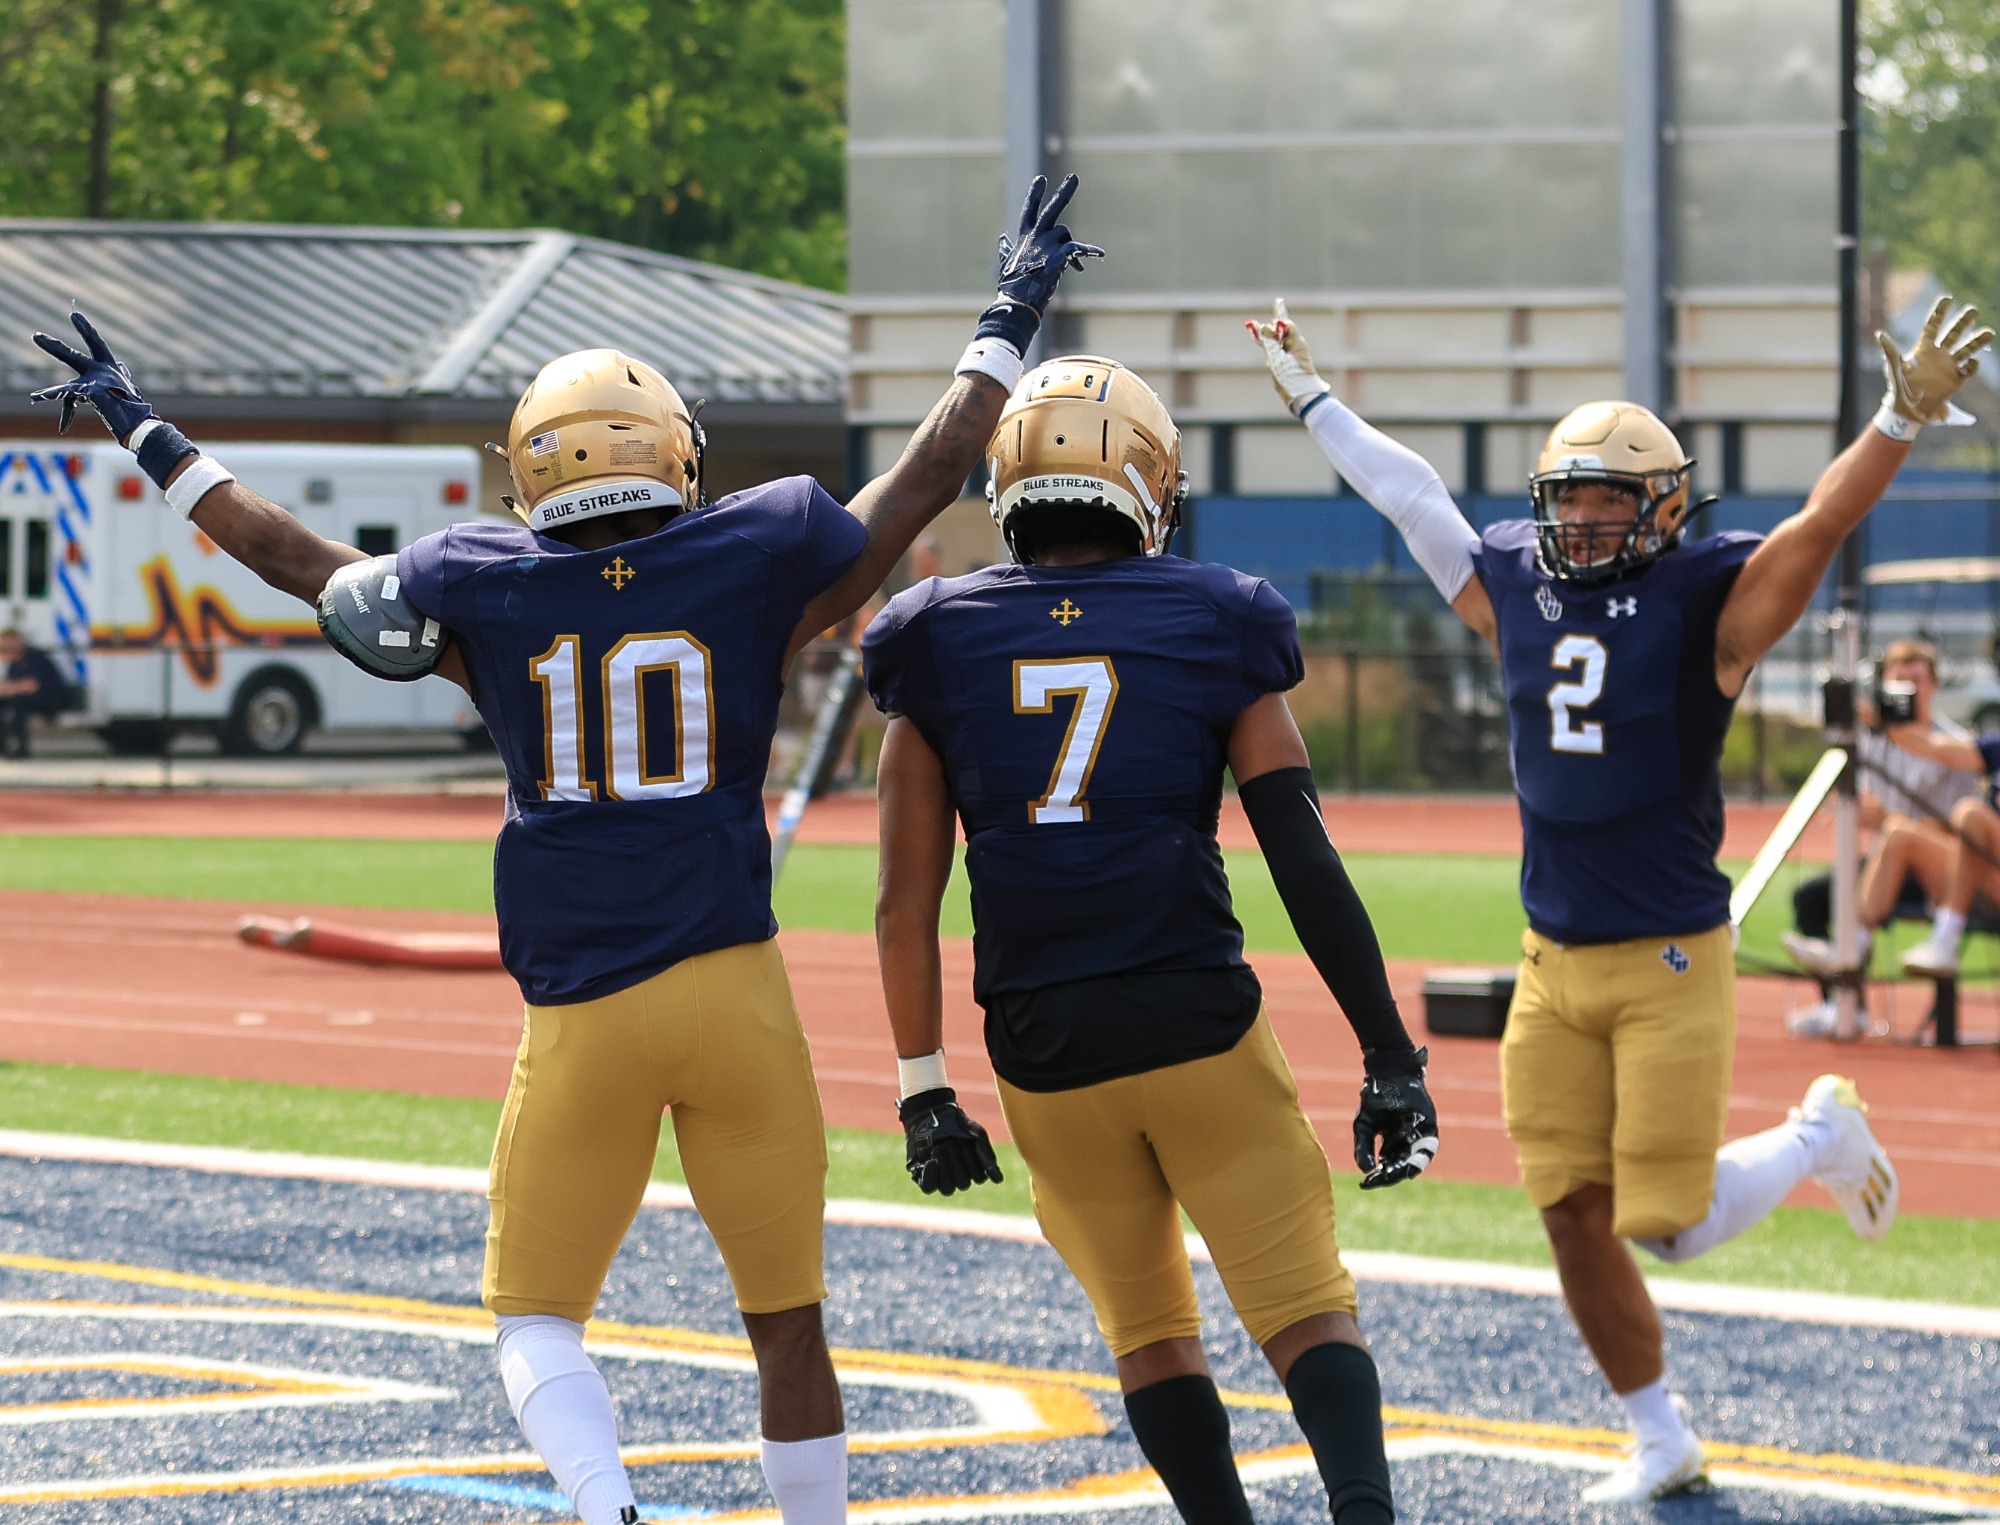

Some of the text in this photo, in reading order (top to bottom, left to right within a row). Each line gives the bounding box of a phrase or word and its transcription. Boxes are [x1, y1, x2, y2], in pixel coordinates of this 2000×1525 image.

[543, 489, 651, 521] BLUE STREAKS
[1024, 478, 1103, 491] BLUE STREAKS
[348, 581, 370, 614] Riddell
[529, 630, 716, 802] 10
[1547, 633, 1610, 755] 2
[1013, 656, 1120, 824] 7
